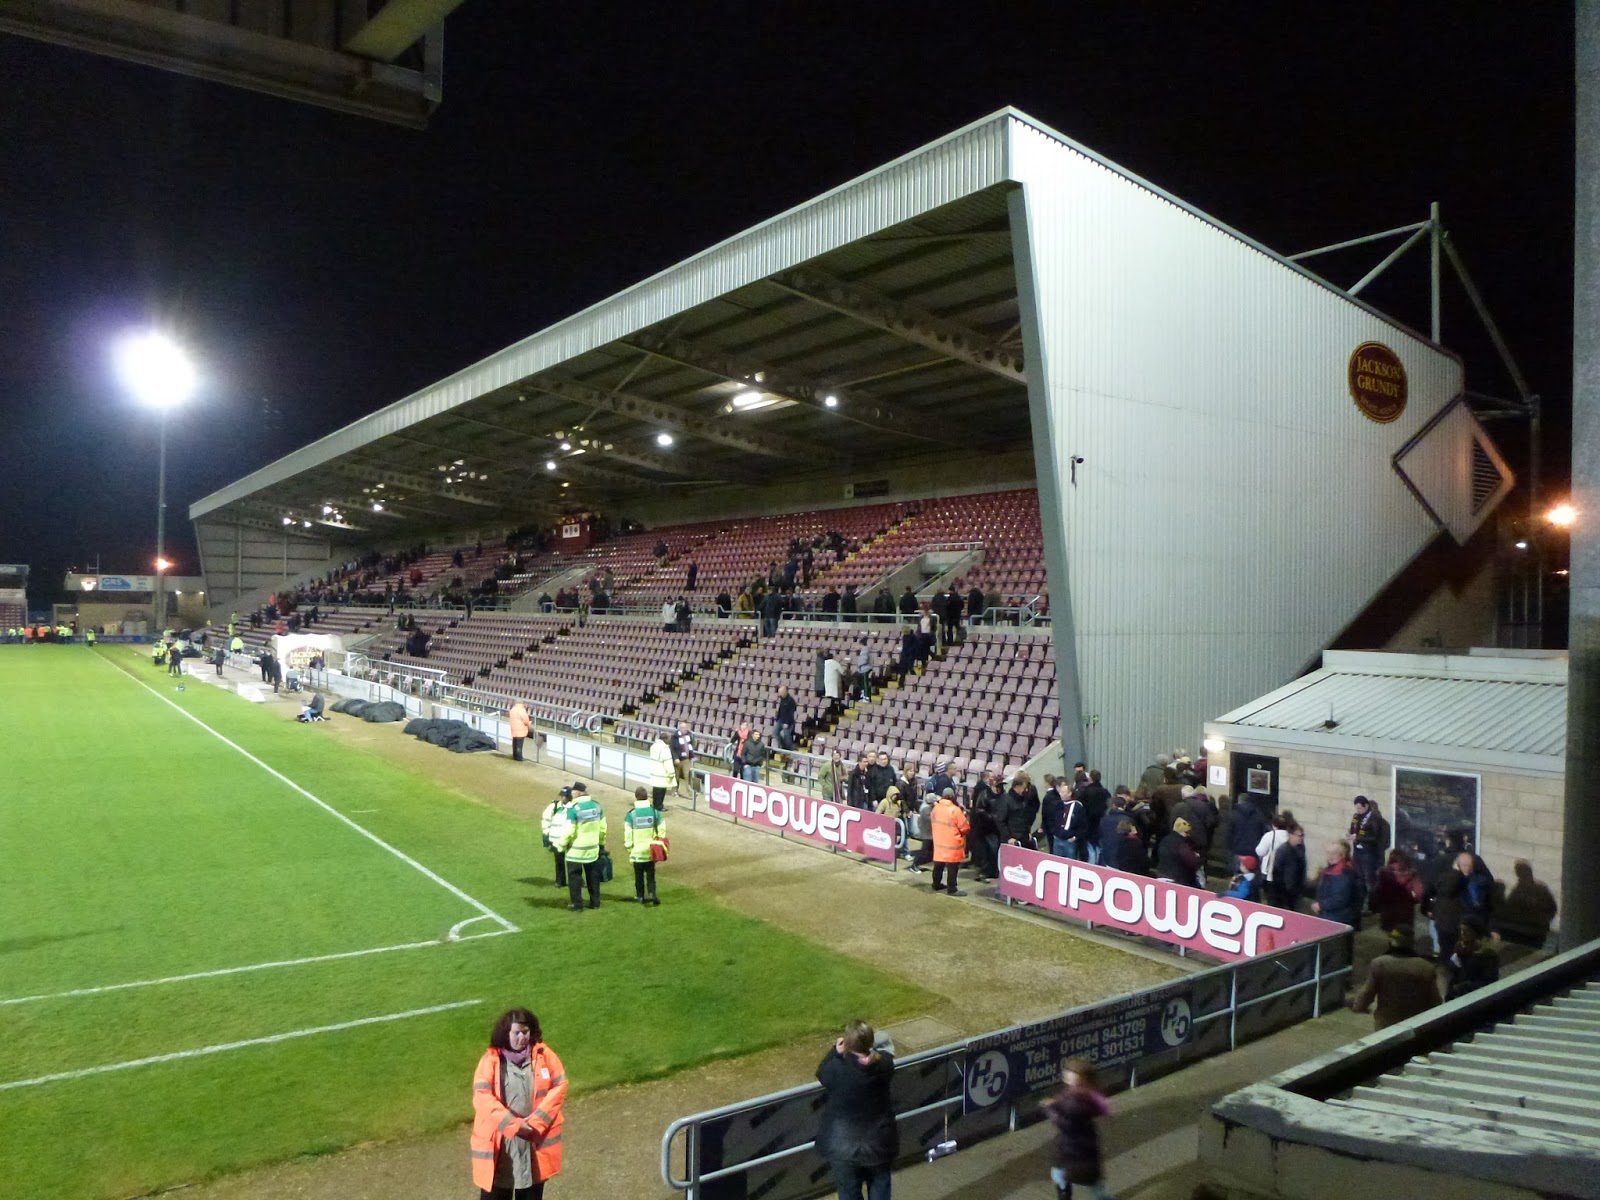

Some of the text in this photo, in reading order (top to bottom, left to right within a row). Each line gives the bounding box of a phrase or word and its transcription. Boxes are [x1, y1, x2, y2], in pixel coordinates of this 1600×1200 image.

[1357, 356, 1400, 379] JACKSON
[1357, 375, 1399, 397] GRUNDY
[731, 781, 861, 845] npower
[1035, 859, 1284, 957] npower
[1025, 1033, 1145, 1083] Mob: 301531
[1026, 1046, 1050, 1065] Tel:
[1060, 1030, 1099, 1055] 01604
[1102, 1018, 1146, 1042] 843709
